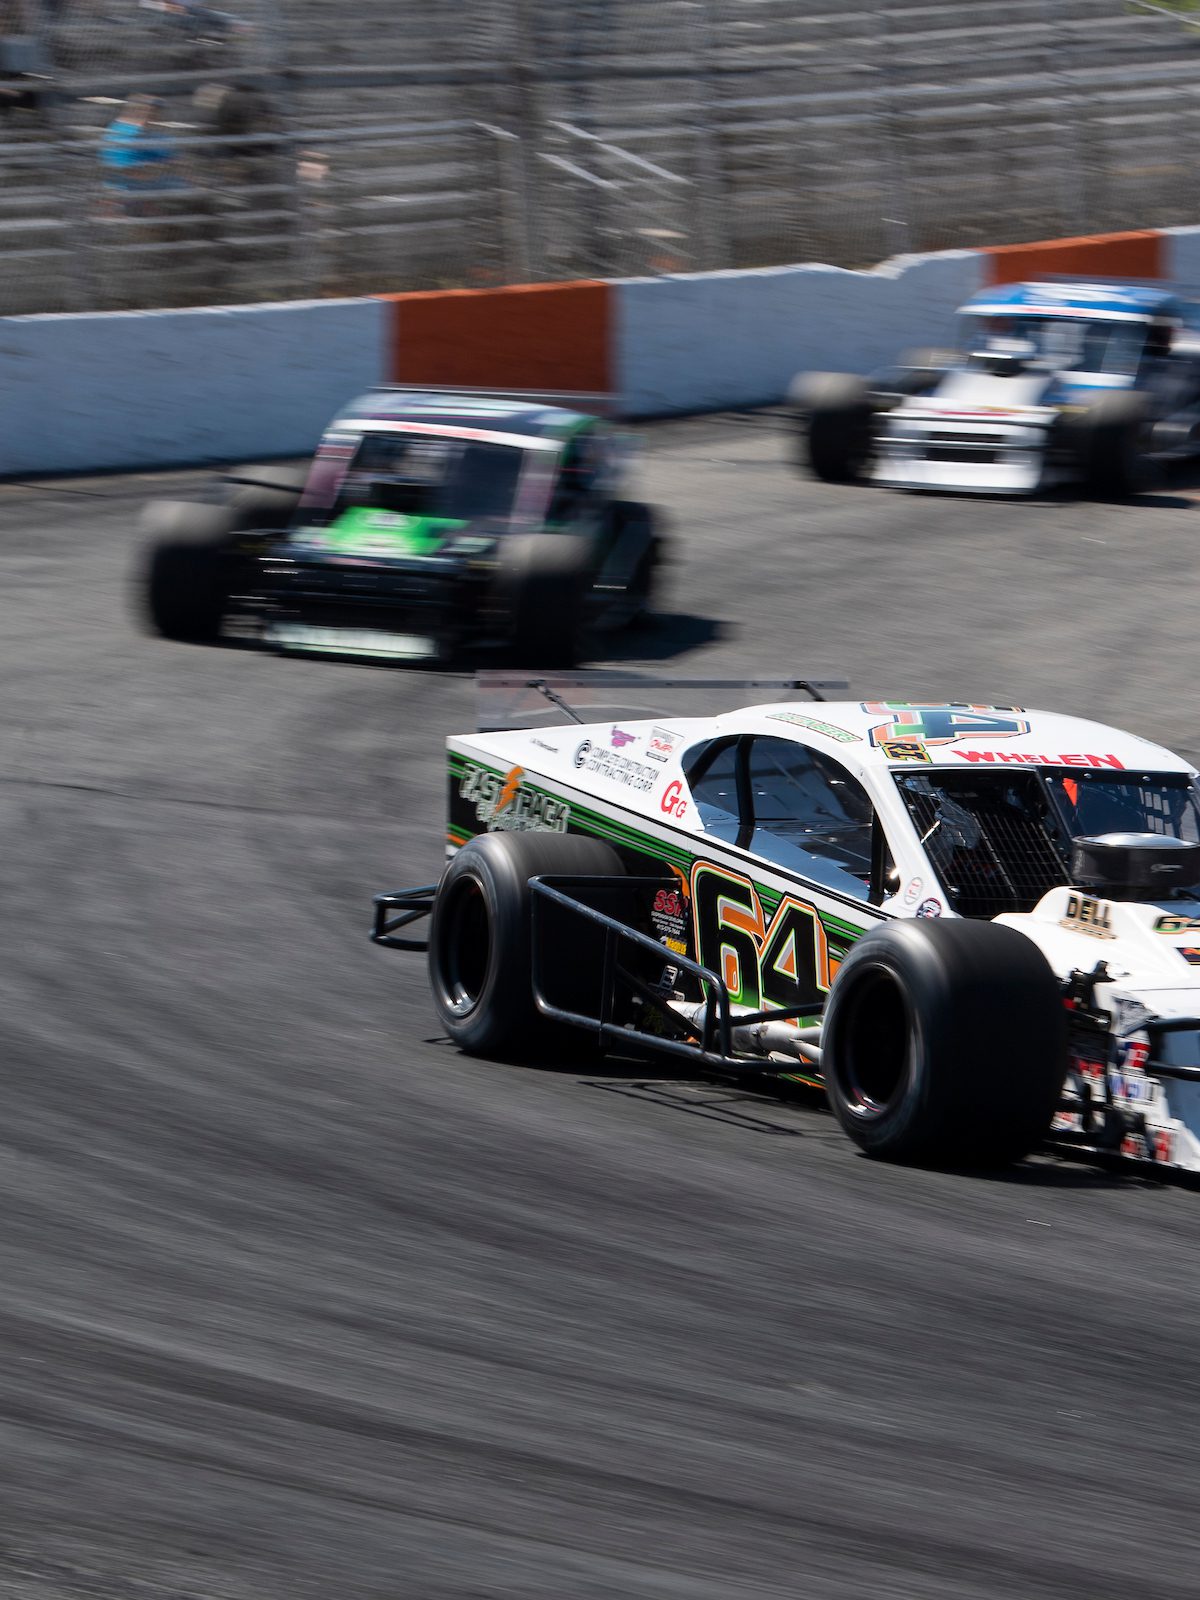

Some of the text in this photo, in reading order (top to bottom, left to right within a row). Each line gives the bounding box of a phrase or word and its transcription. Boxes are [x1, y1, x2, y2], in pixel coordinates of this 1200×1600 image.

[950, 749, 1126, 770] WHELEN
[1065, 893, 1112, 930] DELL
[690, 856, 833, 1028] 64
